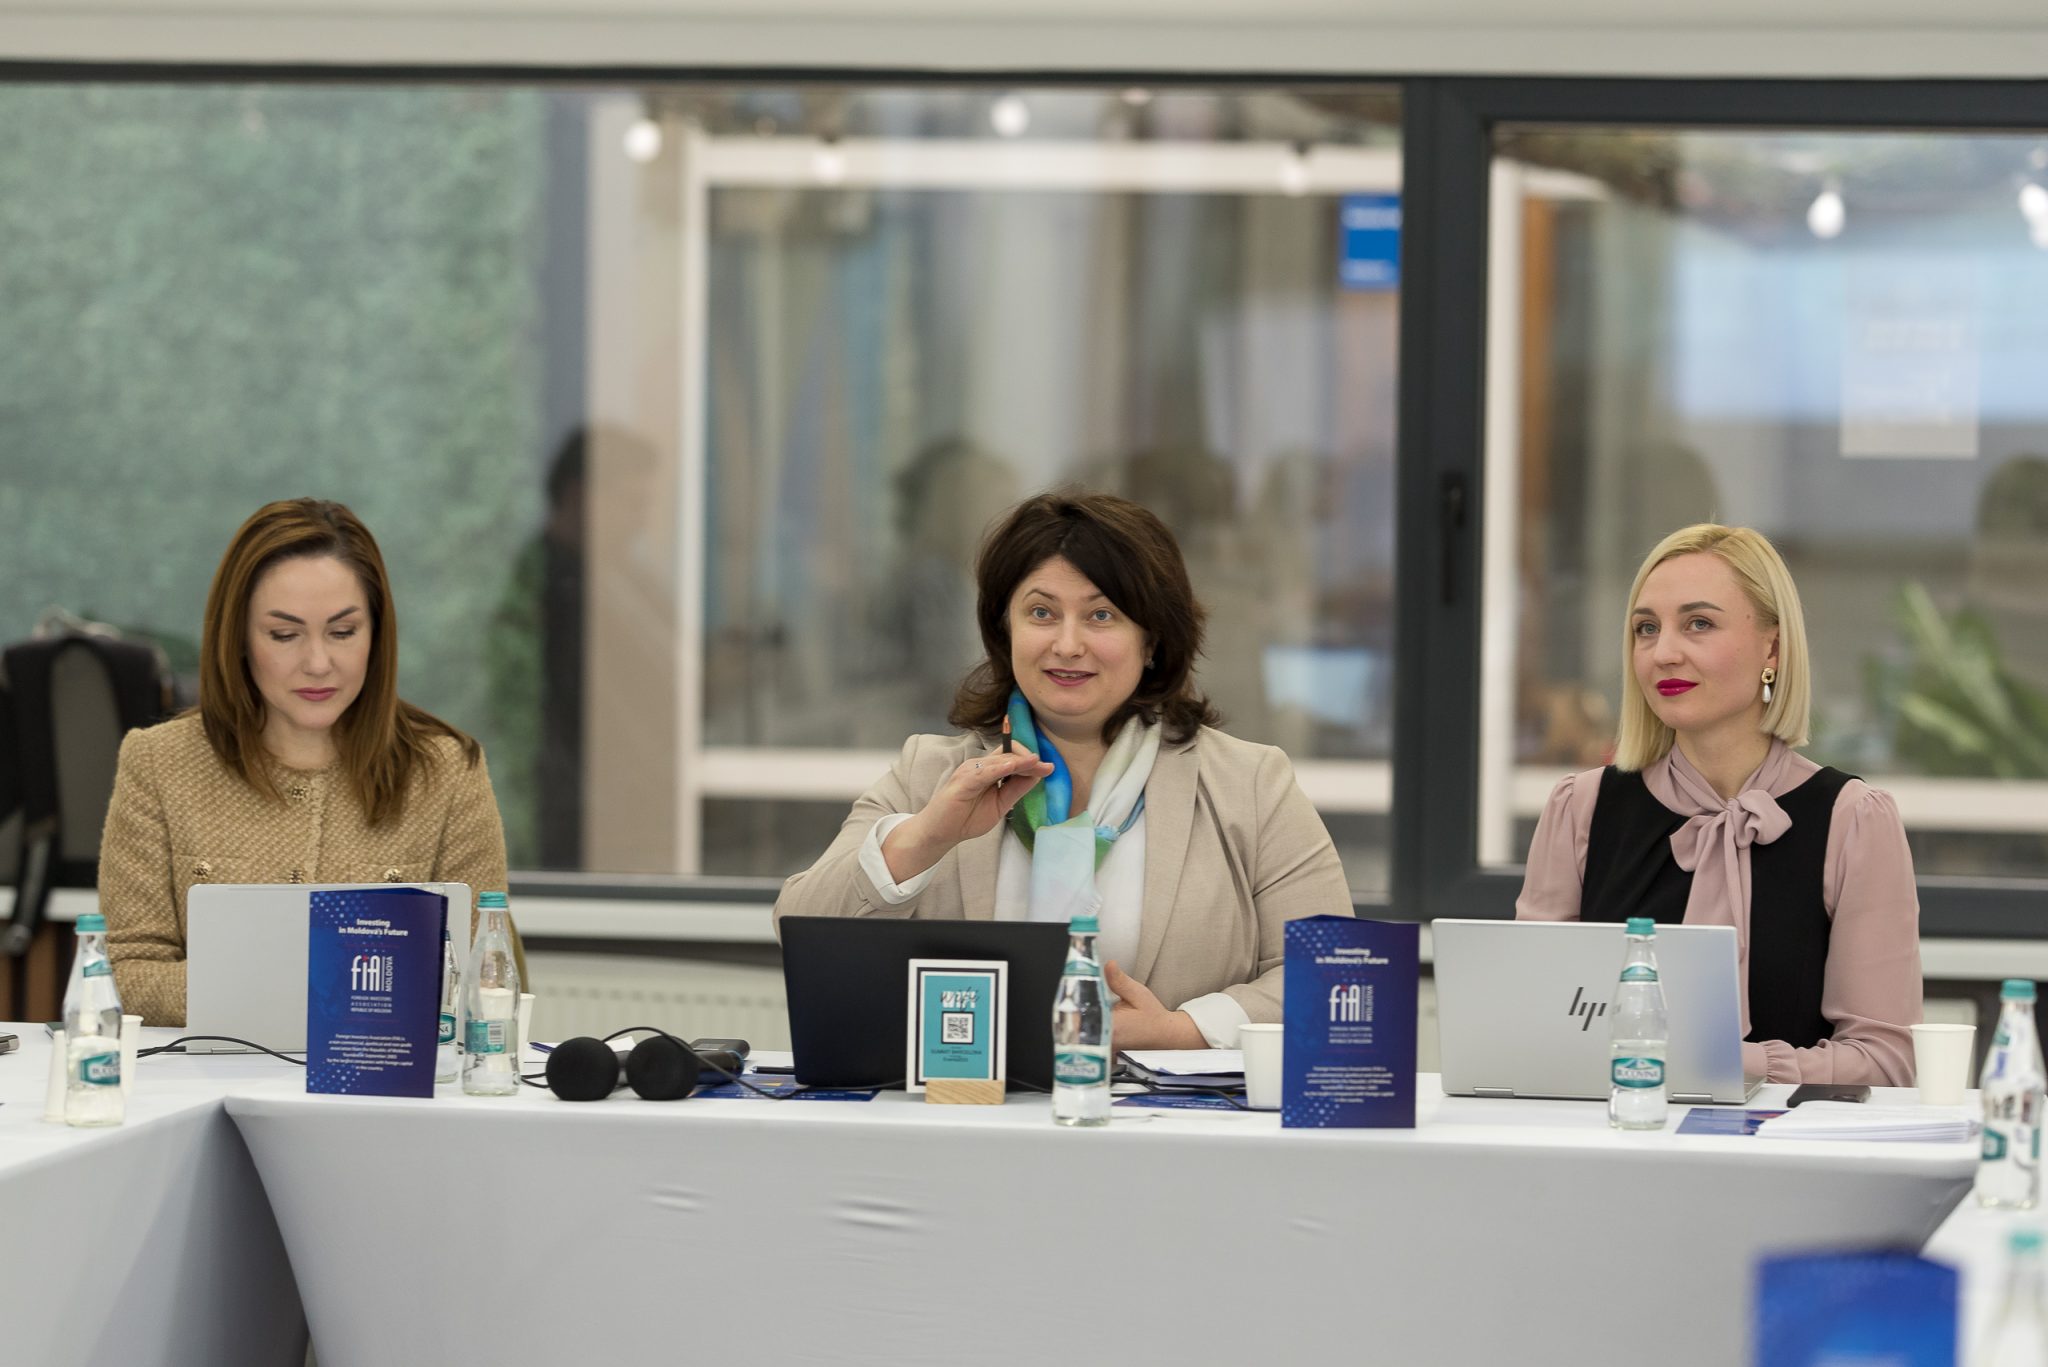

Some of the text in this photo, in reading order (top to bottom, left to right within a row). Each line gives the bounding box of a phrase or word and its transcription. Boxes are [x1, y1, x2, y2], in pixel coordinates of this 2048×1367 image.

[356, 918, 391, 928] Investing
[347, 927, 383, 935] Moldova's
[384, 928, 408, 936] Future
[1334, 947, 1370, 957] Investing
[1315, 956, 1324, 964] in
[1363, 956, 1389, 965] Future
[385, 955, 393, 992] MOLDOVA
[1568, 987, 1607, 1031] hp
